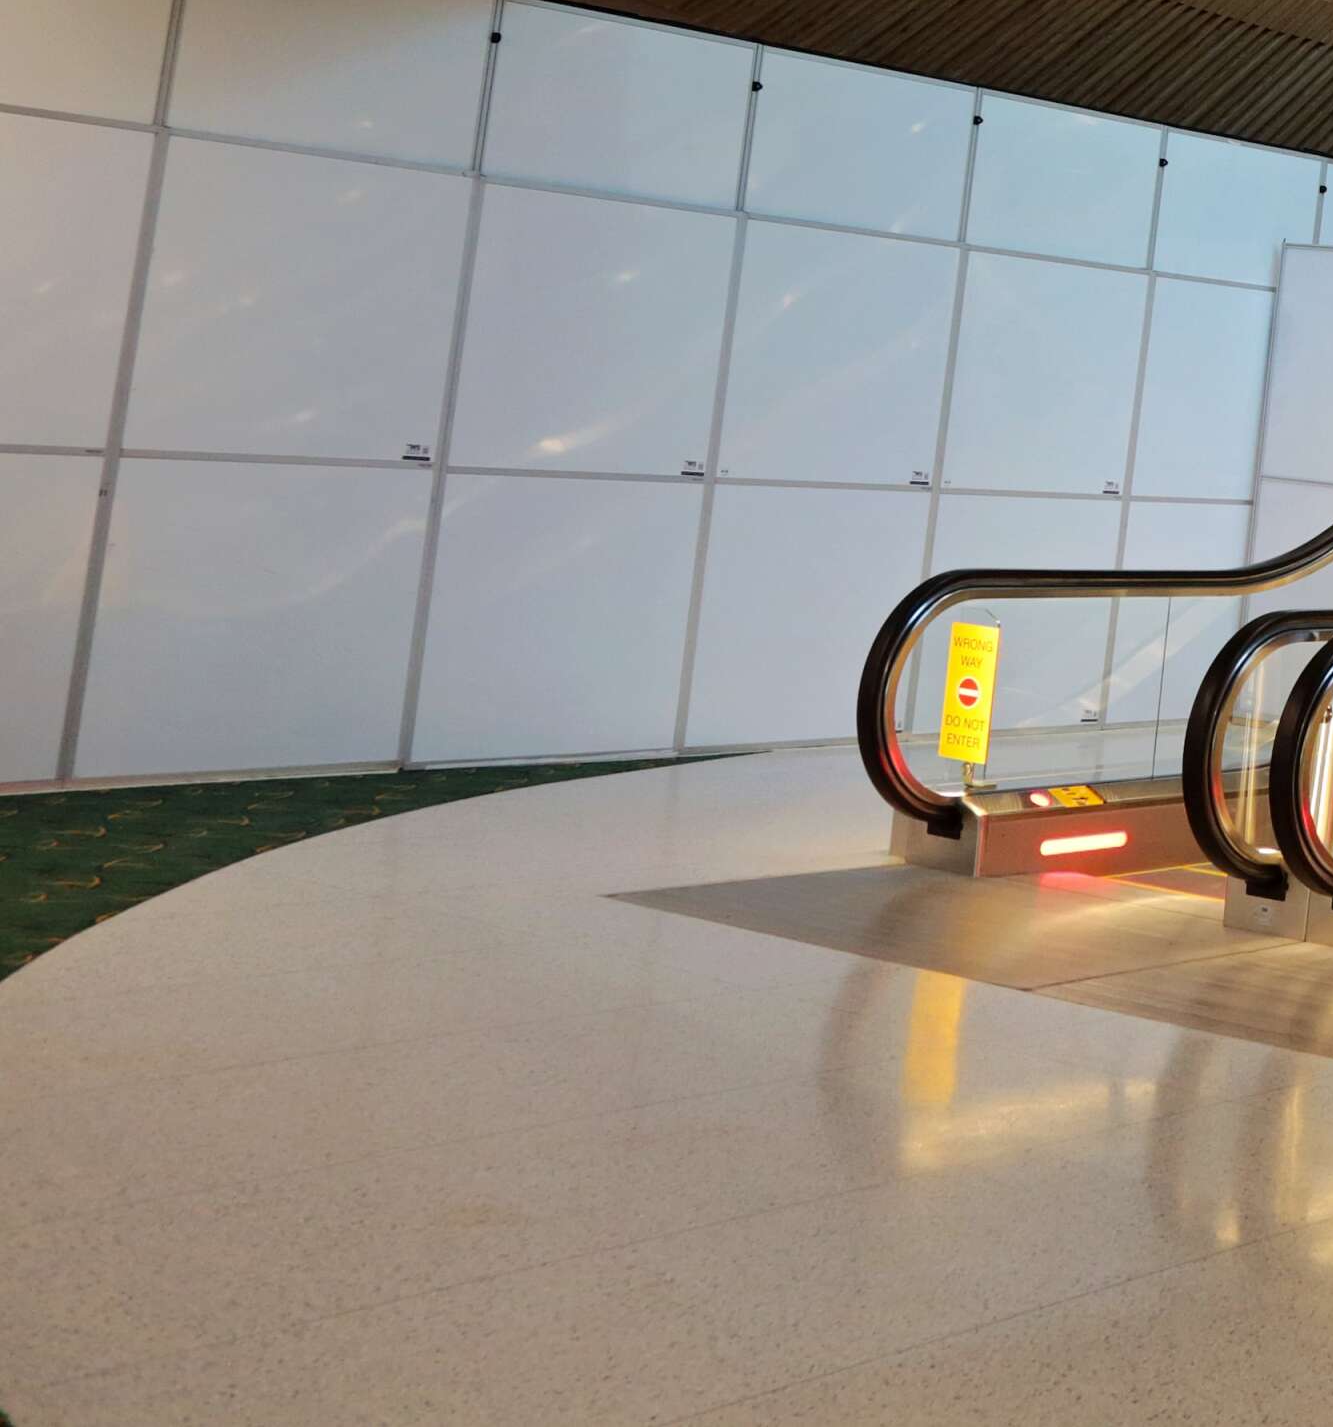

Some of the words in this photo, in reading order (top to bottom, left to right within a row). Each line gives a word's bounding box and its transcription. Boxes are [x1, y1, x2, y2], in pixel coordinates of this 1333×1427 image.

[953, 636, 994, 653] WRONG
[960, 655, 983, 669] WAY
[945, 714, 961, 728] DO
[963, 717, 985, 732] NOT
[947, 733, 981, 749] ENTER
